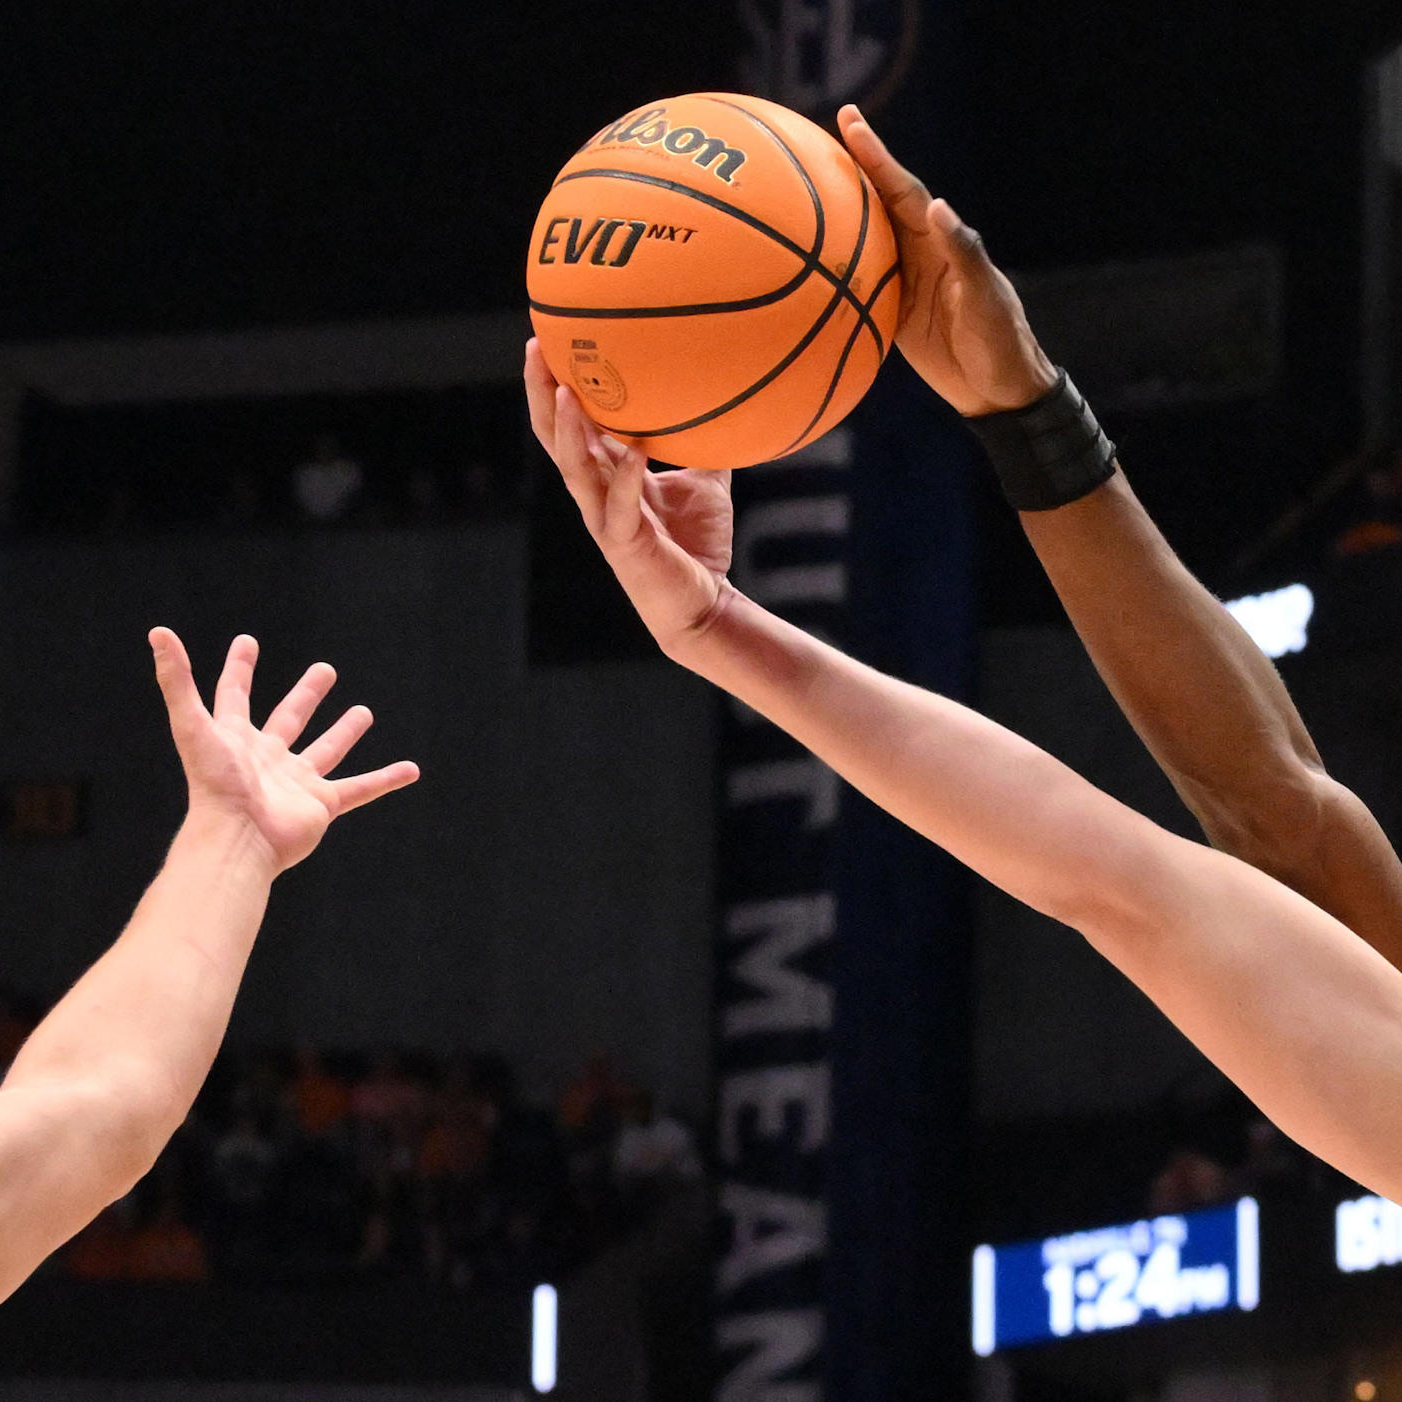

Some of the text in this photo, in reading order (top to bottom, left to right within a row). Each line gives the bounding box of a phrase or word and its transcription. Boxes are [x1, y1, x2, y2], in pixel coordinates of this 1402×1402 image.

[576, 108, 748, 186] ilson
[538, 217, 698, 269] EVO NXT
